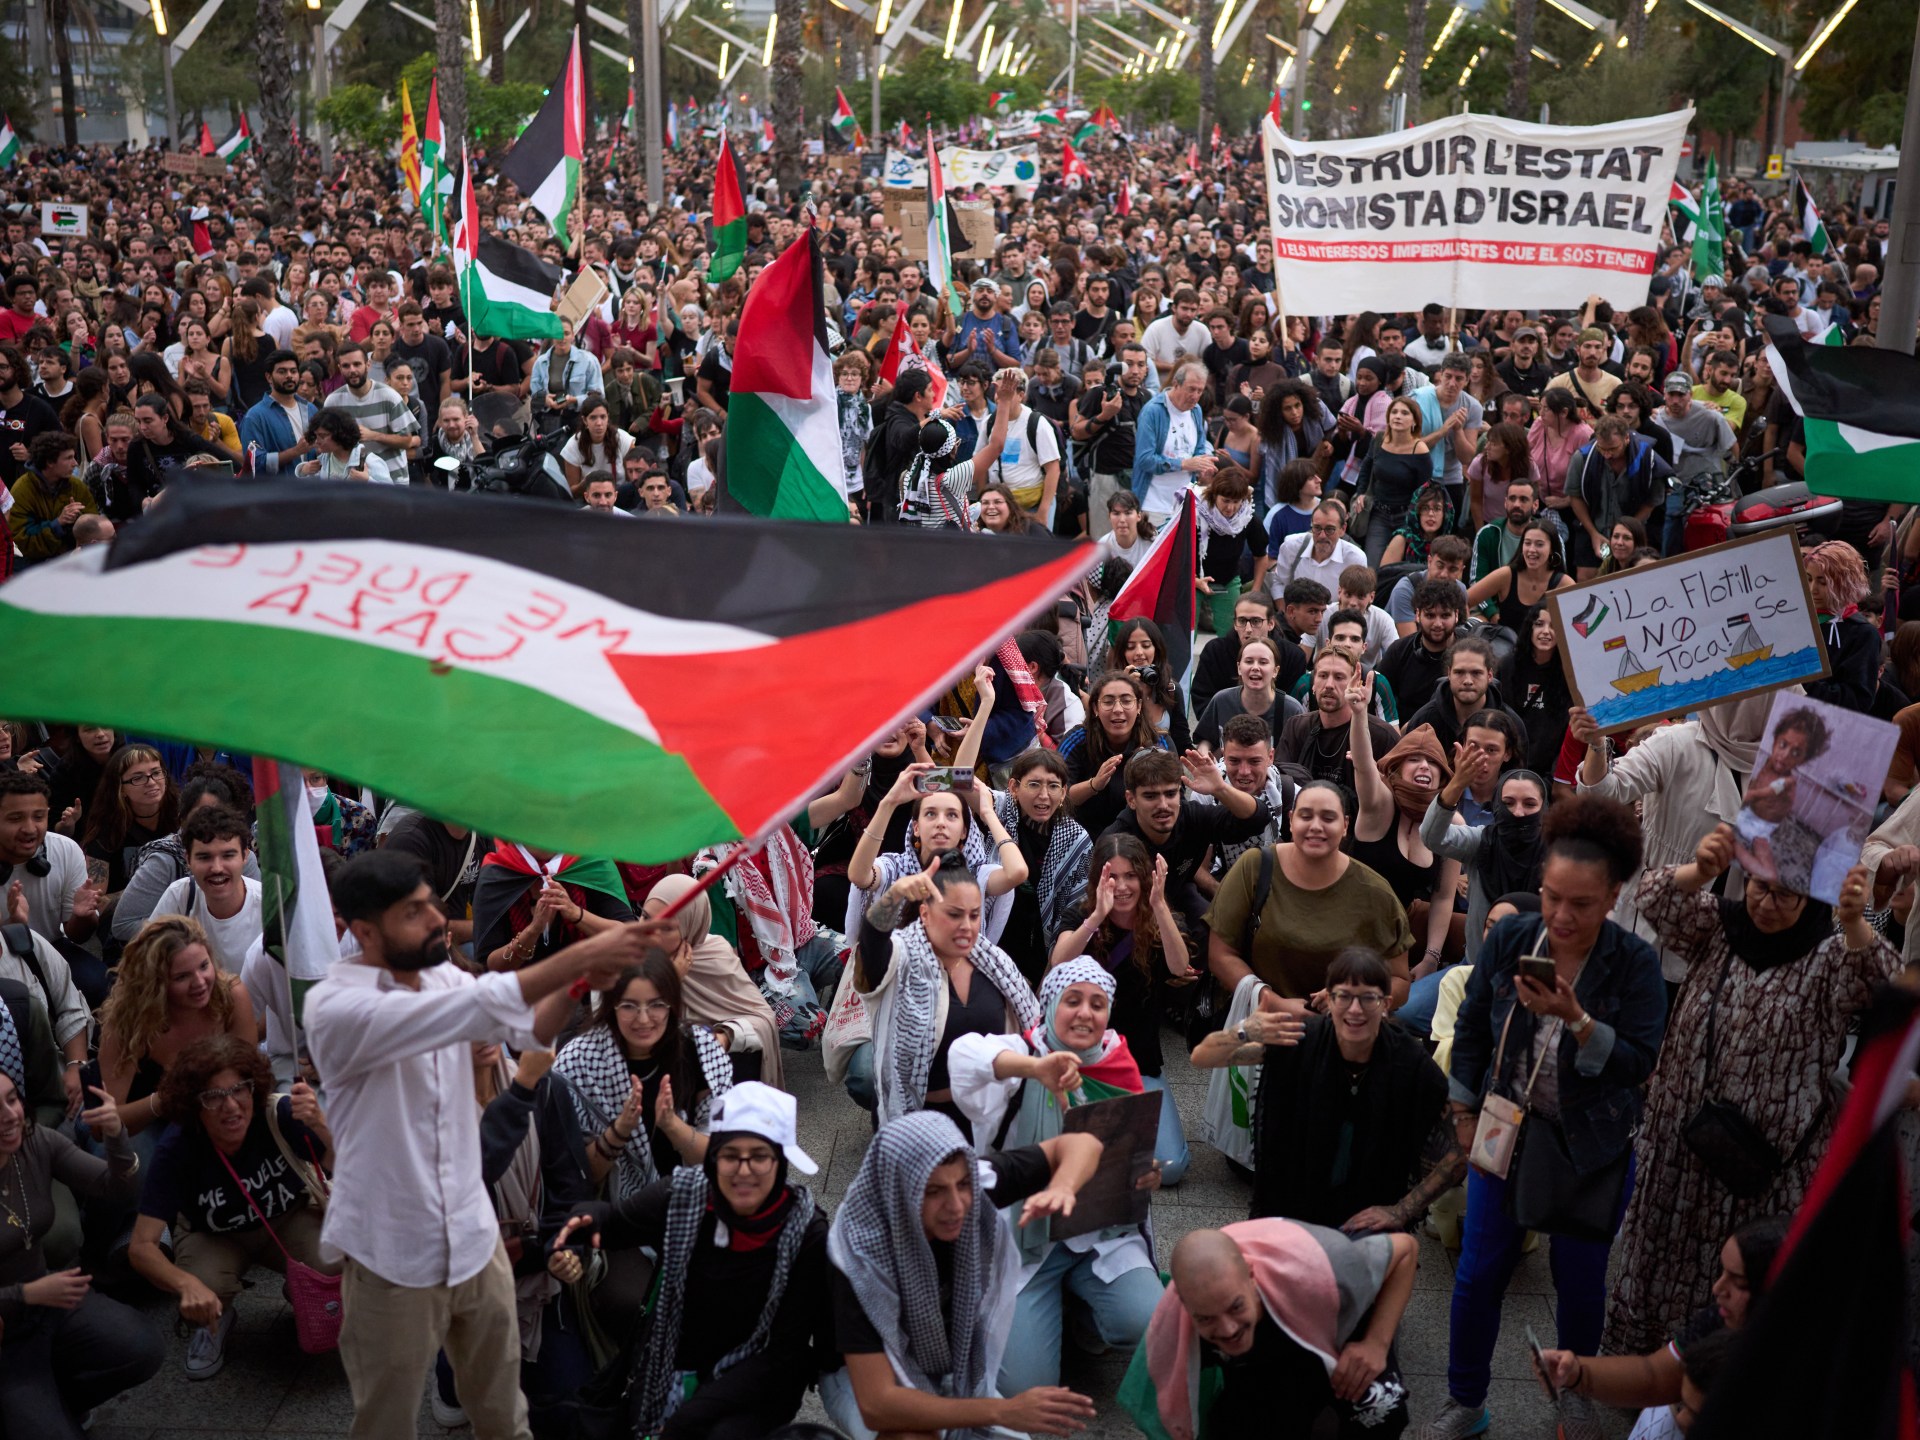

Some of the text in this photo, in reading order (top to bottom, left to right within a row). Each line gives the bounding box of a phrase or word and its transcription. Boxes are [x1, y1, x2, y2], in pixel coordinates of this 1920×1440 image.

[1272, 135, 1664, 187] DESTRUIR L'ESTAT
[1277, 186, 1653, 235] SIONISTA D'ISRAEL
[1281, 241, 1647, 269] I ELS INTERESSOS IMPERIALISTES QUE EL SOSTENEN
[1680, 564, 1777, 609] Flotilla
[1642, 616, 1697, 653] NO
[1657, 627, 1733, 672] Toca!
[198, 1154, 289, 1208] ME DUELE
[206, 1183, 296, 1232] GAZA
